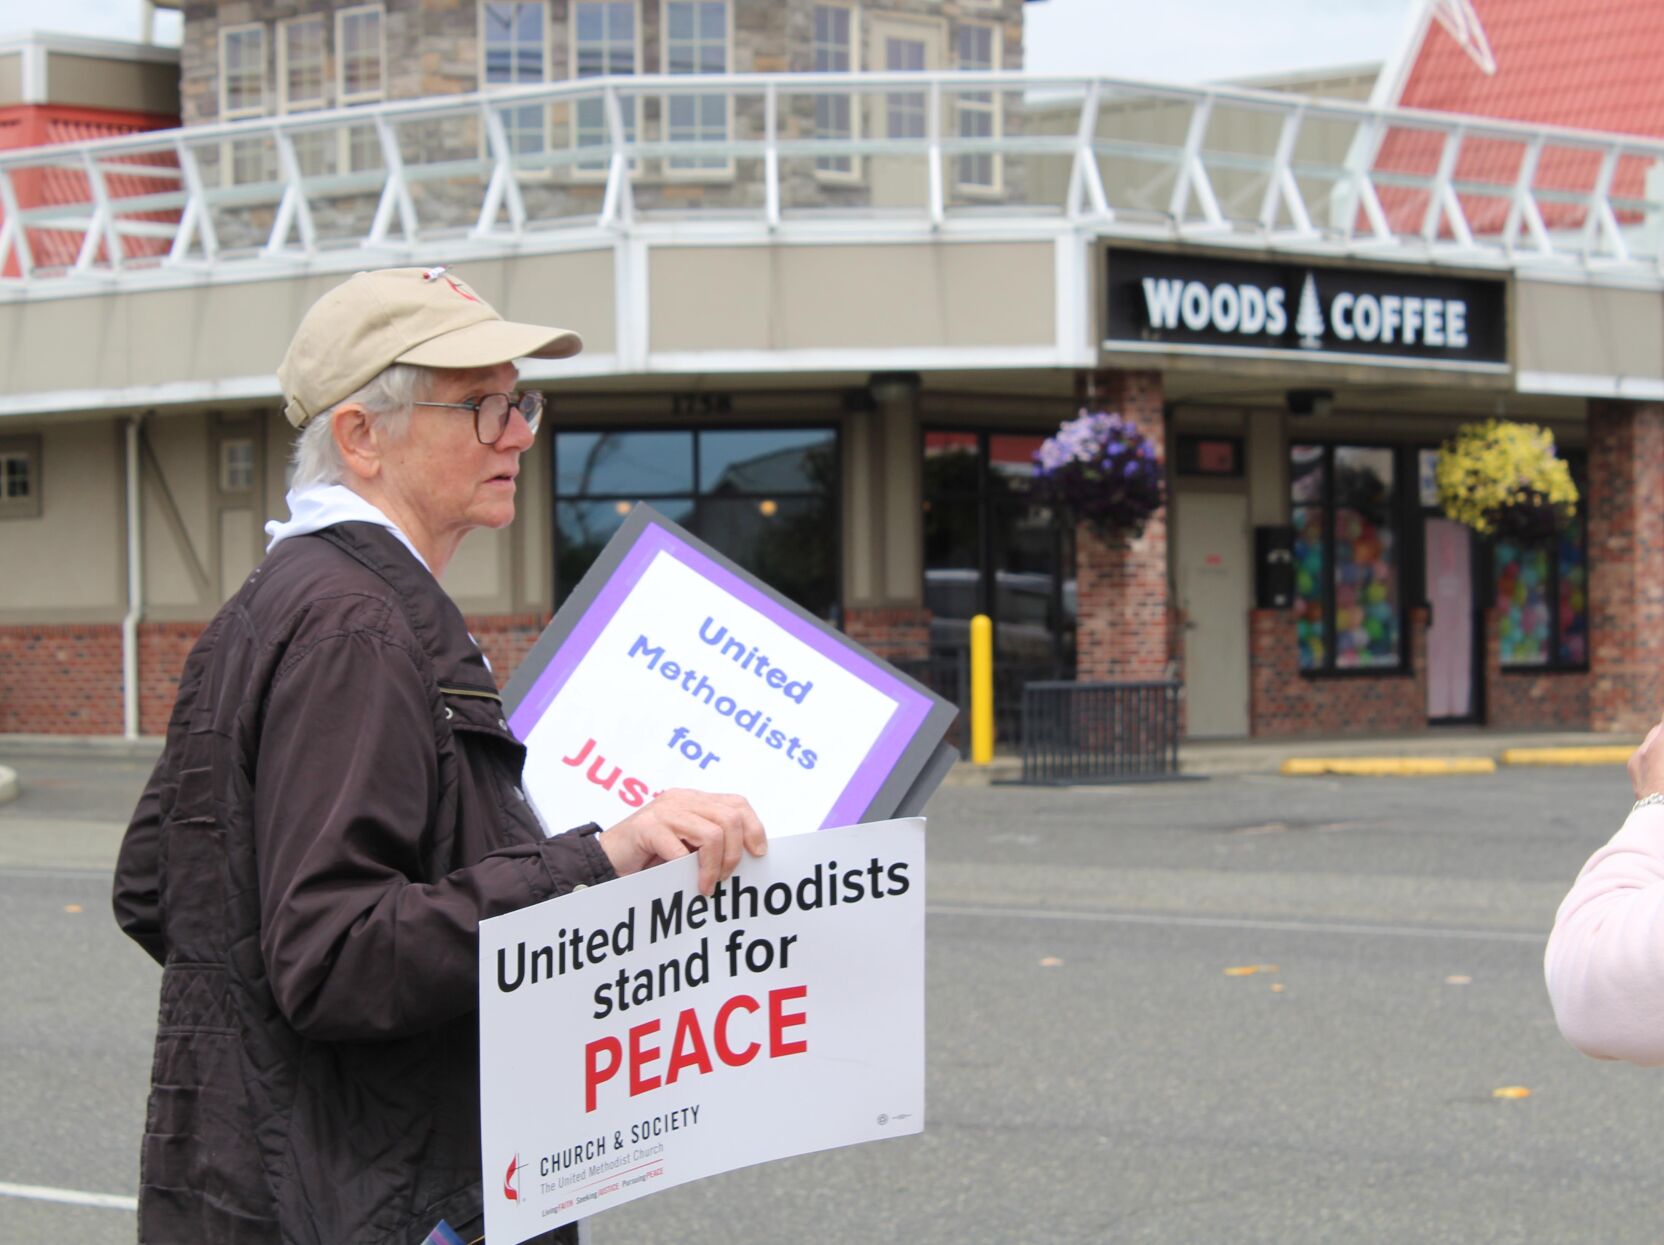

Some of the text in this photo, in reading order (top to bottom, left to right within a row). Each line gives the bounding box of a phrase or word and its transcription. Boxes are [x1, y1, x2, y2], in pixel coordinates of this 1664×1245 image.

[1142, 277, 1469, 348] WOODS COFFEE
[627, 634, 818, 771] Methodists
[698, 616, 814, 705] United
[667, 726, 721, 770] for
[497, 857, 911, 993] United Methodists
[592, 929, 798, 1020] stand for
[585, 984, 808, 1114] PEACE
[539, 1104, 701, 1177] CHURCH & SOCIETY
[541, 1143, 665, 1195] The United Methodist Church
